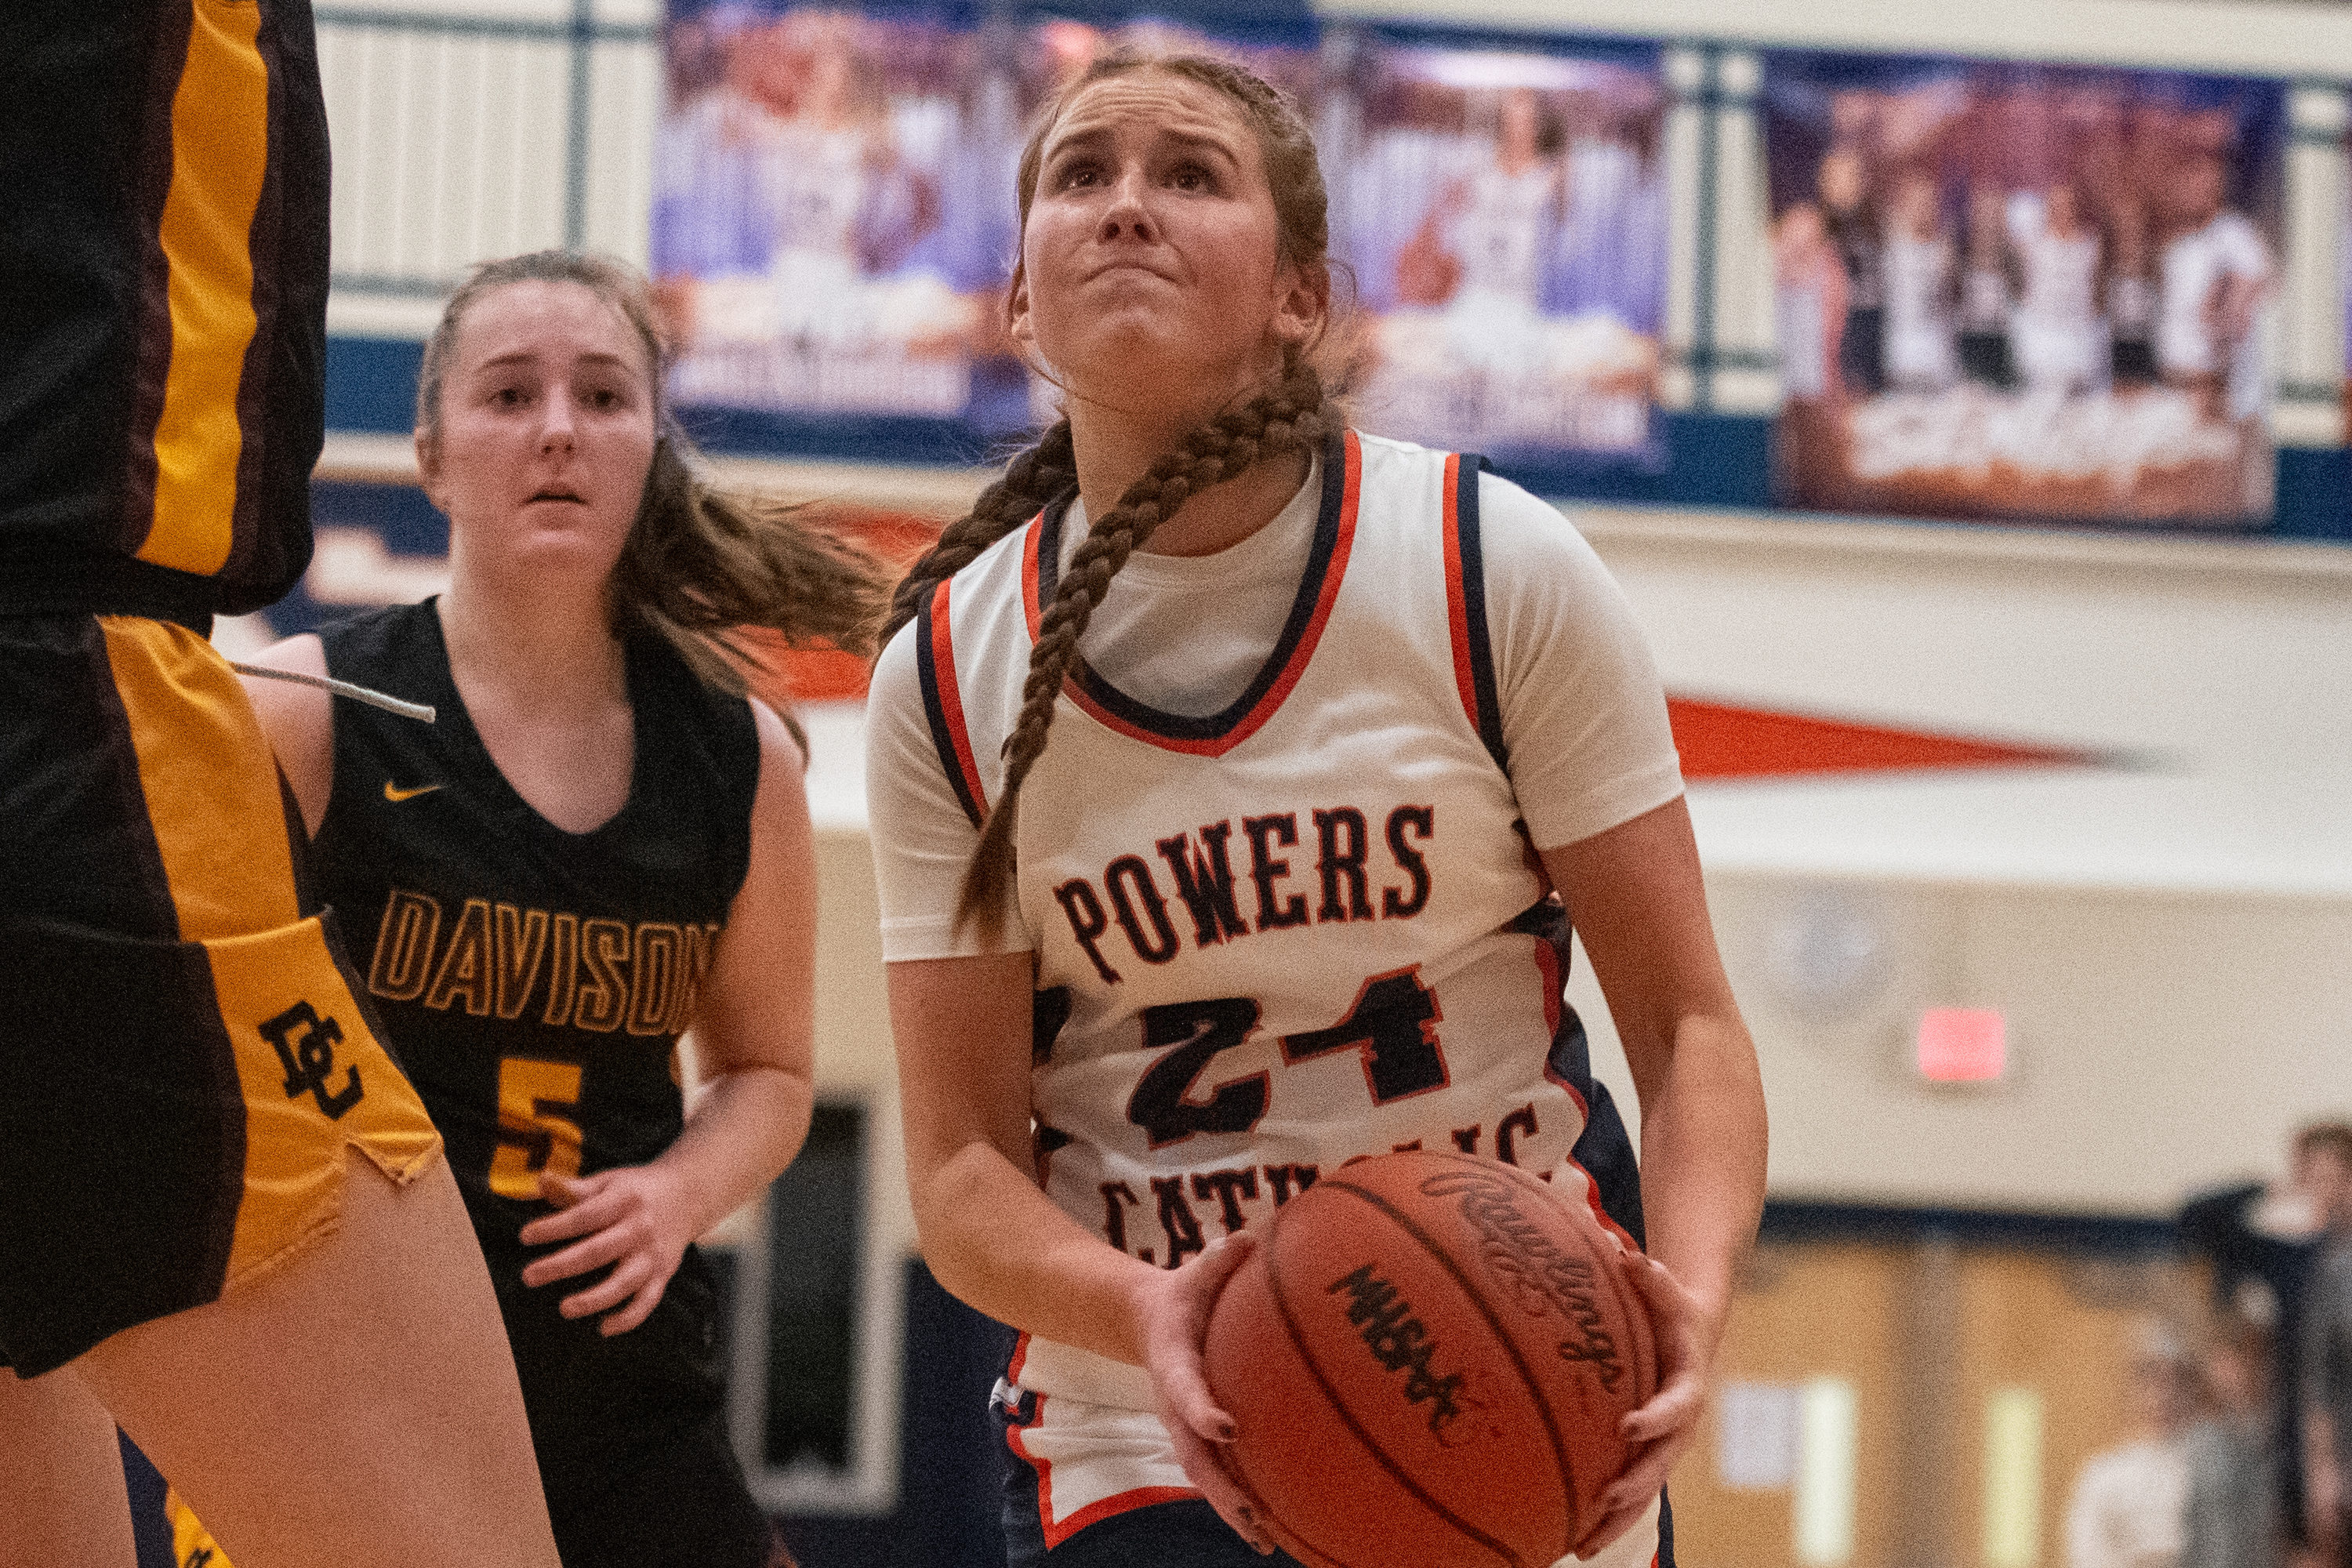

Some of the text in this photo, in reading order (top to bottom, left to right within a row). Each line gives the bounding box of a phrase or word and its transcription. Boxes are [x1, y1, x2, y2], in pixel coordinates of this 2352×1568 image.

[1052, 804, 1435, 984] POWERS
[488, 1057, 583, 1200] 5
[1126, 963, 1451, 1151] 24
[1420, 1171, 1624, 1395] Rawlings
